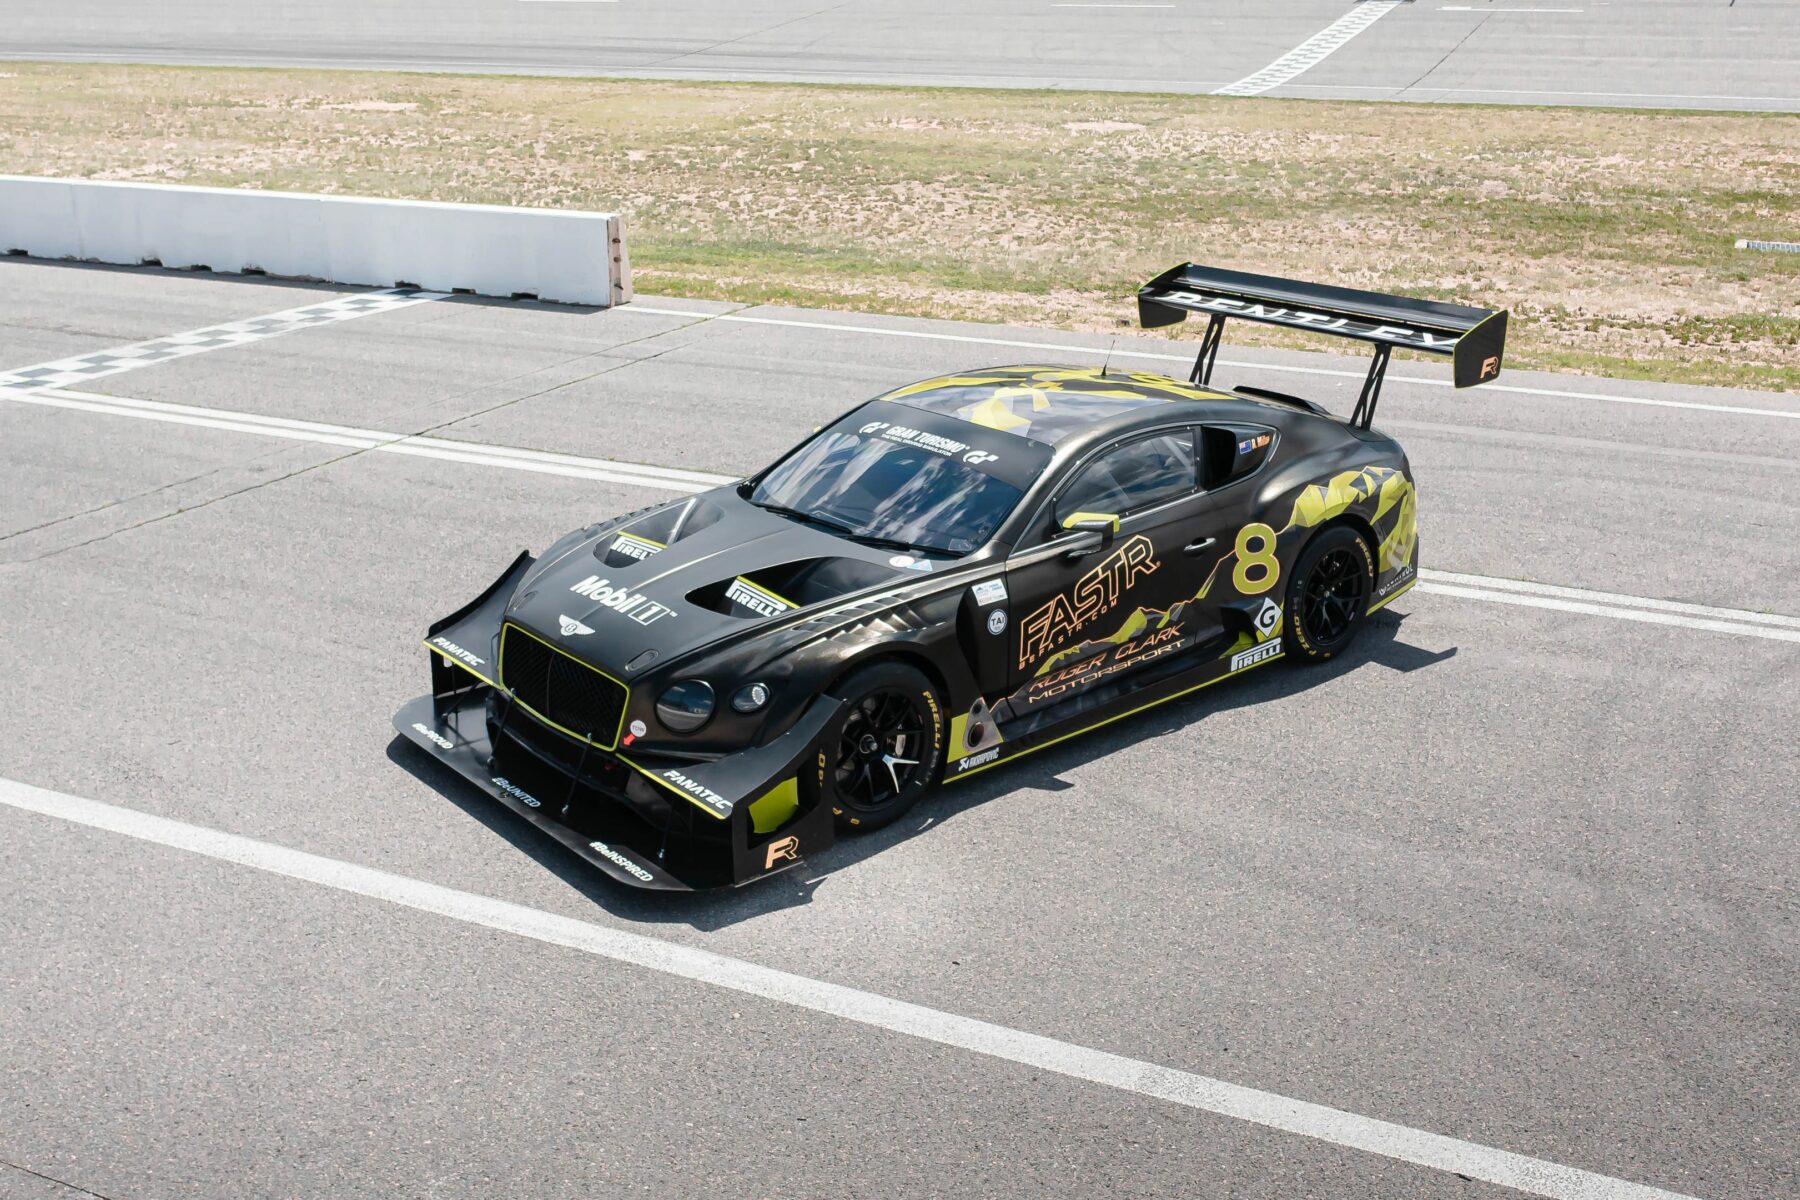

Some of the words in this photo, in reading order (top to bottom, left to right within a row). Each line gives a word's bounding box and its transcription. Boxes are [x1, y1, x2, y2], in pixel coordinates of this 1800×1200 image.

[885, 425, 920, 440] GRAN
[914, 432, 966, 453] TURISMO
[610, 535, 662, 561] PIREL
[1232, 522, 1281, 595] 8
[569, 575, 648, 613] Mobil
[1018, 534, 1158, 664] FASTR
[1259, 605, 1277, 629] G
[432, 637, 486, 667] FANATEC
[1028, 638, 1186, 704] MOTORSPORT
[1029, 652, 1108, 693] ROGER
[1114, 621, 1186, 660] CLARK
[1230, 637, 1282, 672] PIRELLI
[412, 722, 454, 750] #BePROUD
[922, 690, 941, 750] PIRELLI
[491, 776, 542, 808] #BeUNITED
[663, 769, 734, 811] FANATEC
[589, 841, 654, 882] #BeINSPIRED
